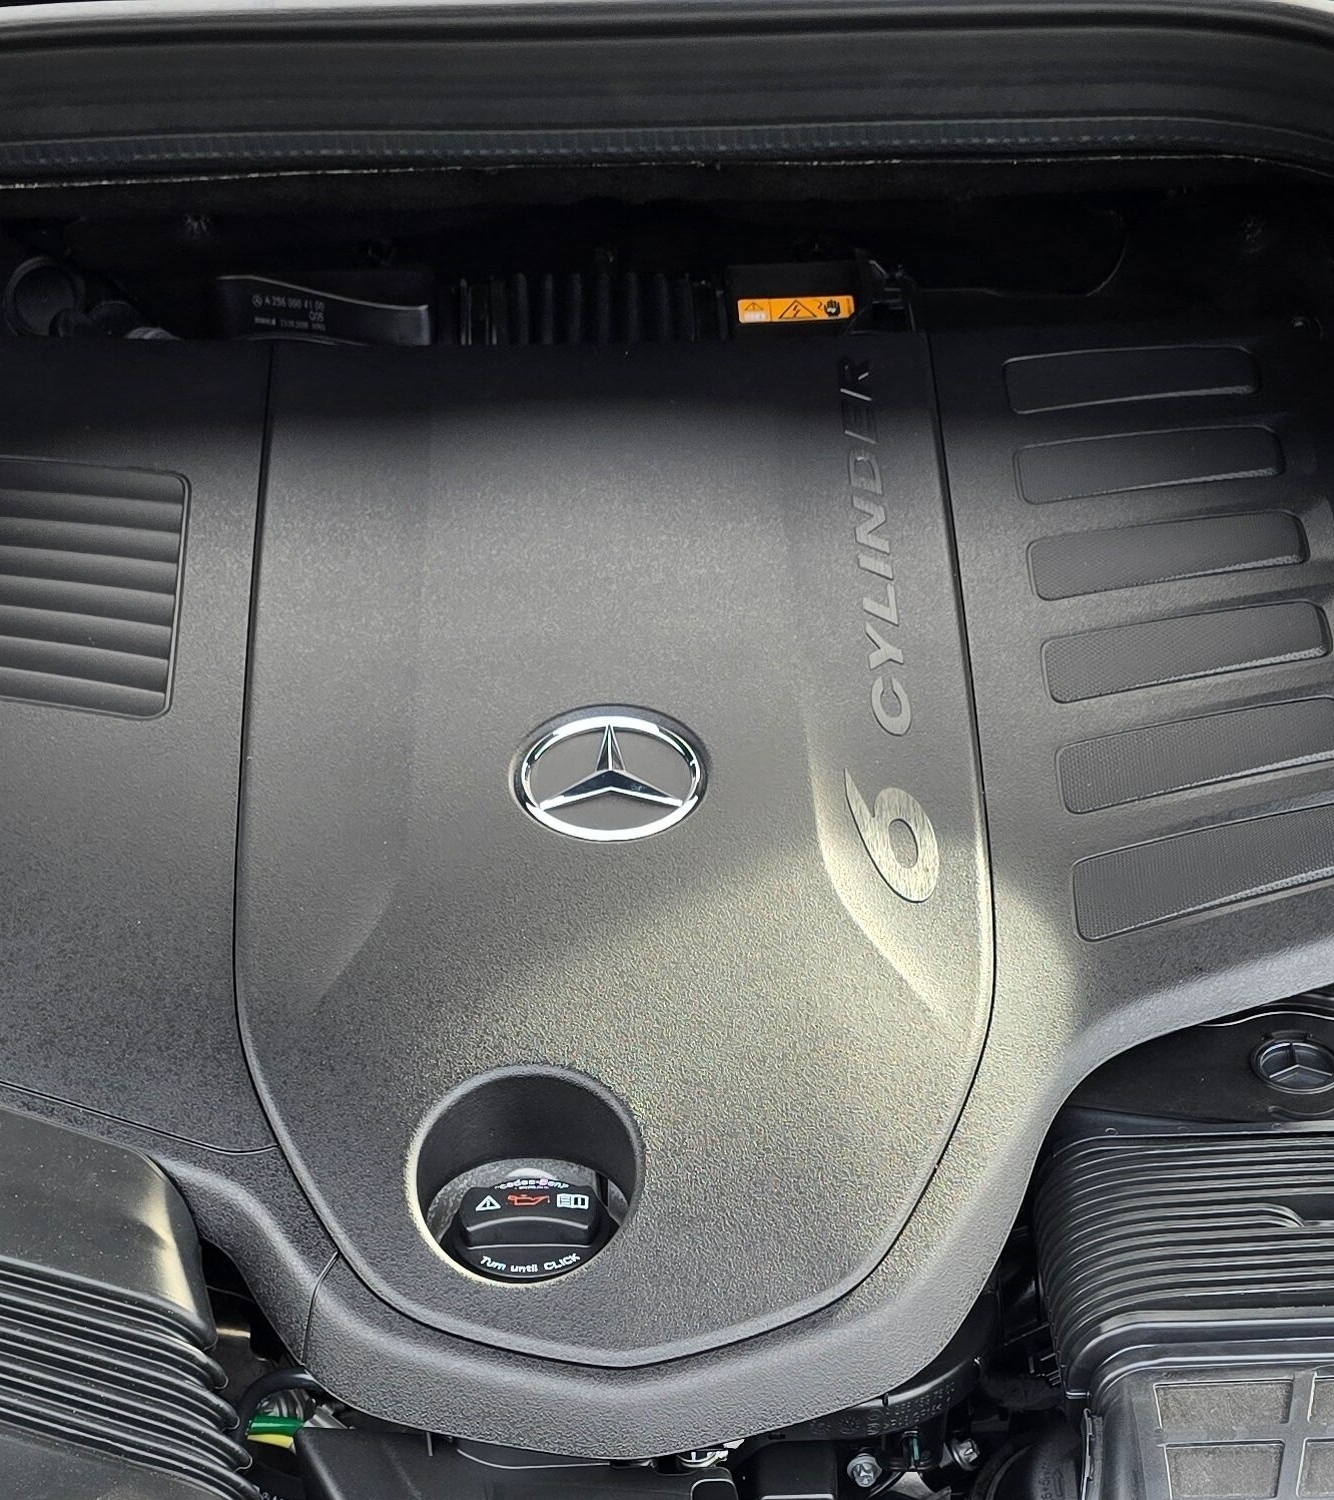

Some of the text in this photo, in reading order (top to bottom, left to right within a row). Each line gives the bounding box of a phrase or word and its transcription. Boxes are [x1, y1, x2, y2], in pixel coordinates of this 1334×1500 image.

[837, 354, 941, 903] 6 CYLINDER
[480, 1253, 581, 1273] Turn until CLICK
